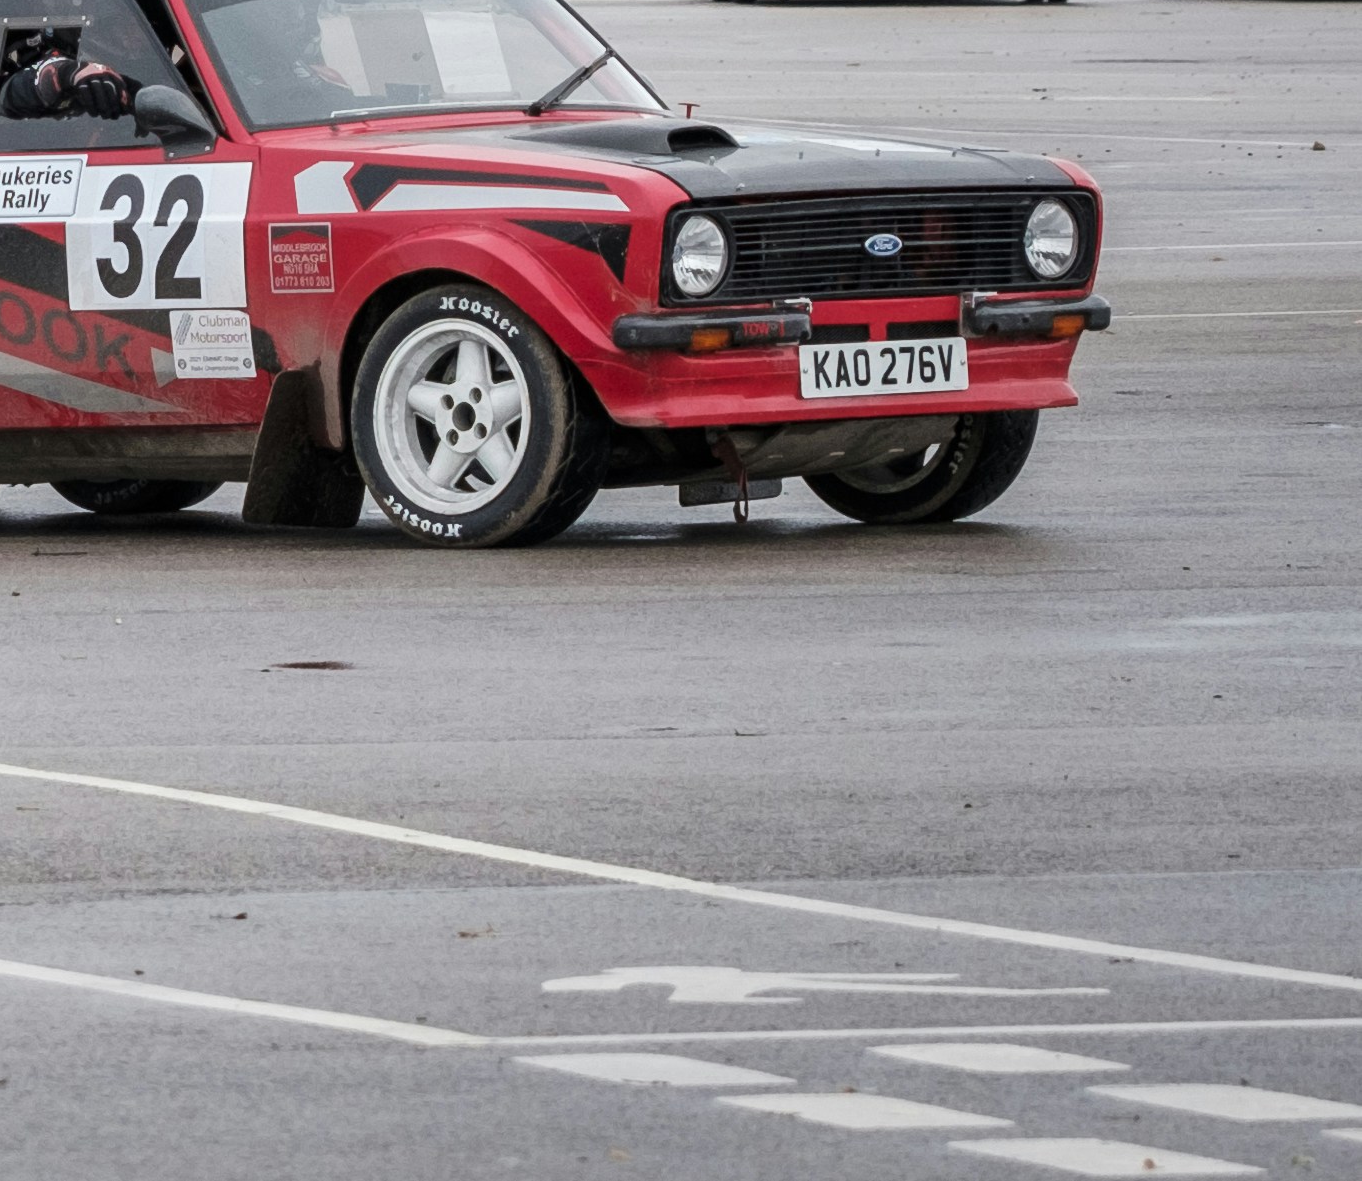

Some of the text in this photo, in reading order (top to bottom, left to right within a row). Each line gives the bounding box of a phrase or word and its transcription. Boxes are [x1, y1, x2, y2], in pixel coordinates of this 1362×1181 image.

[2, 188, 51, 214] Rally
[96, 174, 205, 300] 32
[273, 243, 328, 252] MIDDLEBROOK
[274, 253, 327, 263] GARAGE
[275, 275, 298, 287] 01773
[198, 315, 248, 327] Clubman
[742, 323, 769, 336] TOW
[190, 332, 250, 344] Motorsport
[813, 344, 953, 390] KAO 276V
